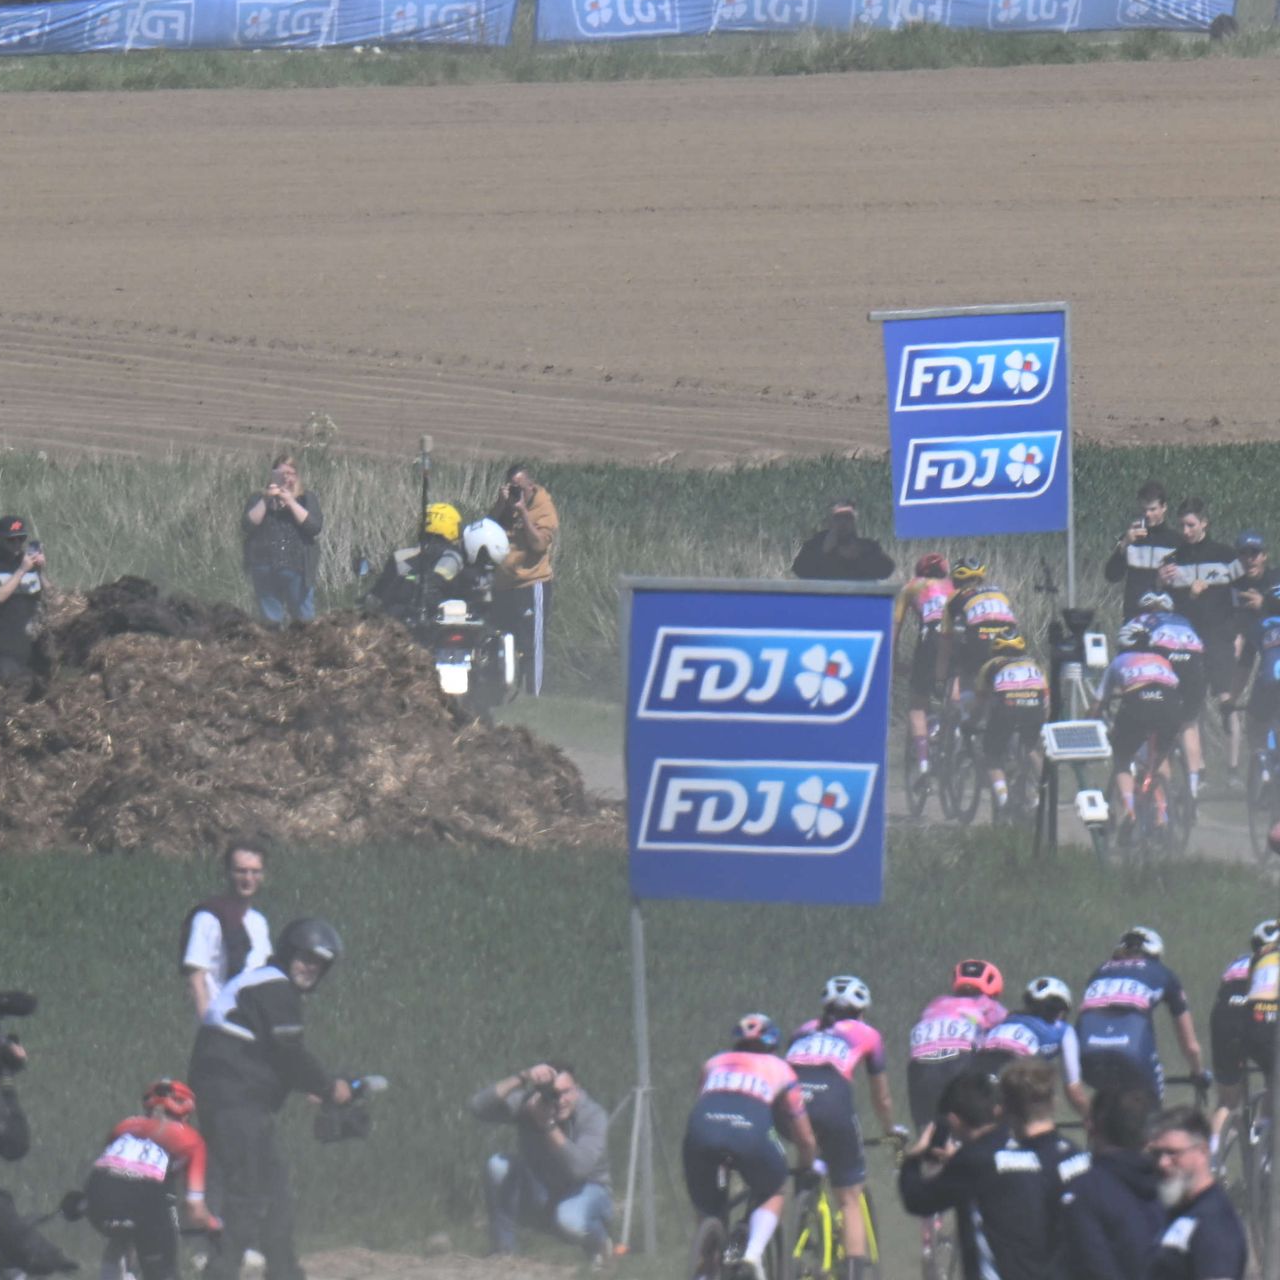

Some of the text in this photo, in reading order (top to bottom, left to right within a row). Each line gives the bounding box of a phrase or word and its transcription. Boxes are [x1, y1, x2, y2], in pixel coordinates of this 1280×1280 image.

[910, 353, 996, 398] FDJ
[915, 447, 1000, 490] FDJ
[660, 645, 788, 702] FDJ
[657, 777, 785, 835] FDJ
